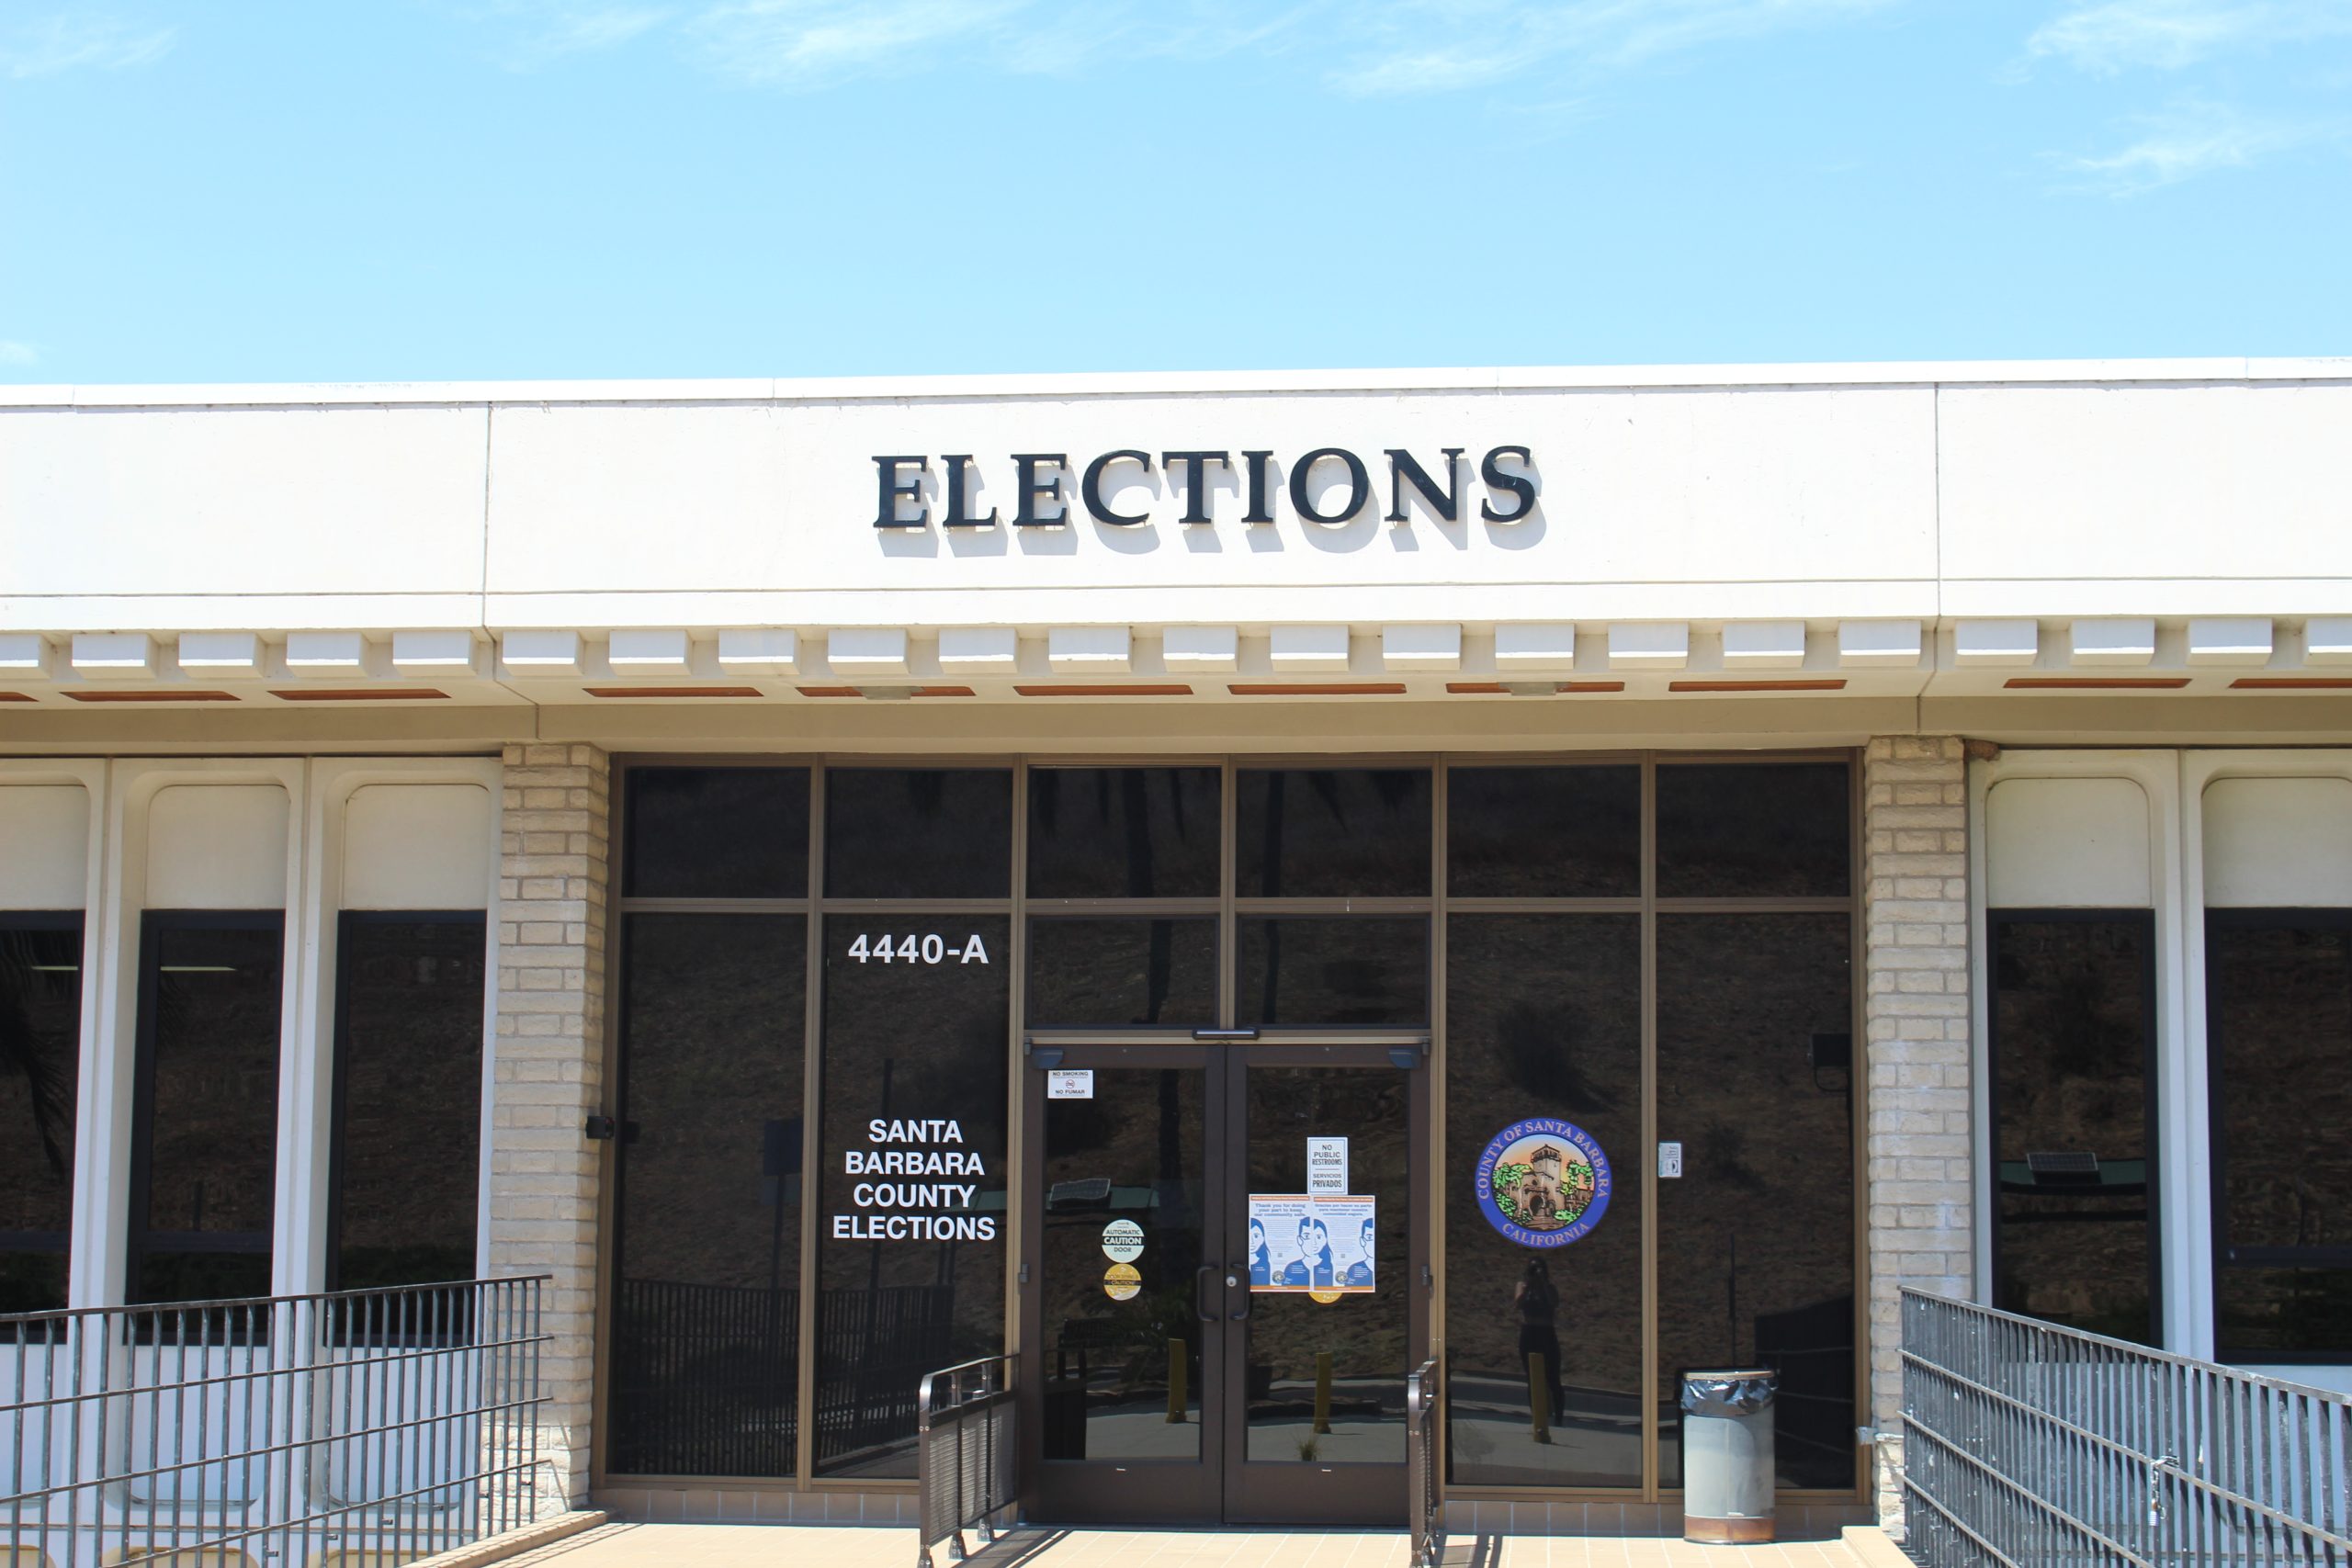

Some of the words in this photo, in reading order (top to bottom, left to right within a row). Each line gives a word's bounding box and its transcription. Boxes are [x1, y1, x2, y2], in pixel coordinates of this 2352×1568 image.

[871, 445, 1537, 528] ELECTIONS
[848, 933, 989, 964] 4440-A
[868, 1119, 964, 1144] SANTA
[845, 1151, 985, 1176] BARBARA
[1477, 1140, 1504, 1200] COUNTY
[1504, 1124, 1522, 1142] OF
[1524, 1121, 1572, 1138] SANTA
[1574, 1132, 1609, 1198] BARBARA
[853, 1182, 977, 1208] COUNTY
[1312, 1179, 1342, 1188] PRIVADOS
[832, 1215, 996, 1241] ELECTIONS
[1103, 1236, 1142, 1245] CAUTION
[1502, 1222, 1591, 1246] CALIFORNIA
